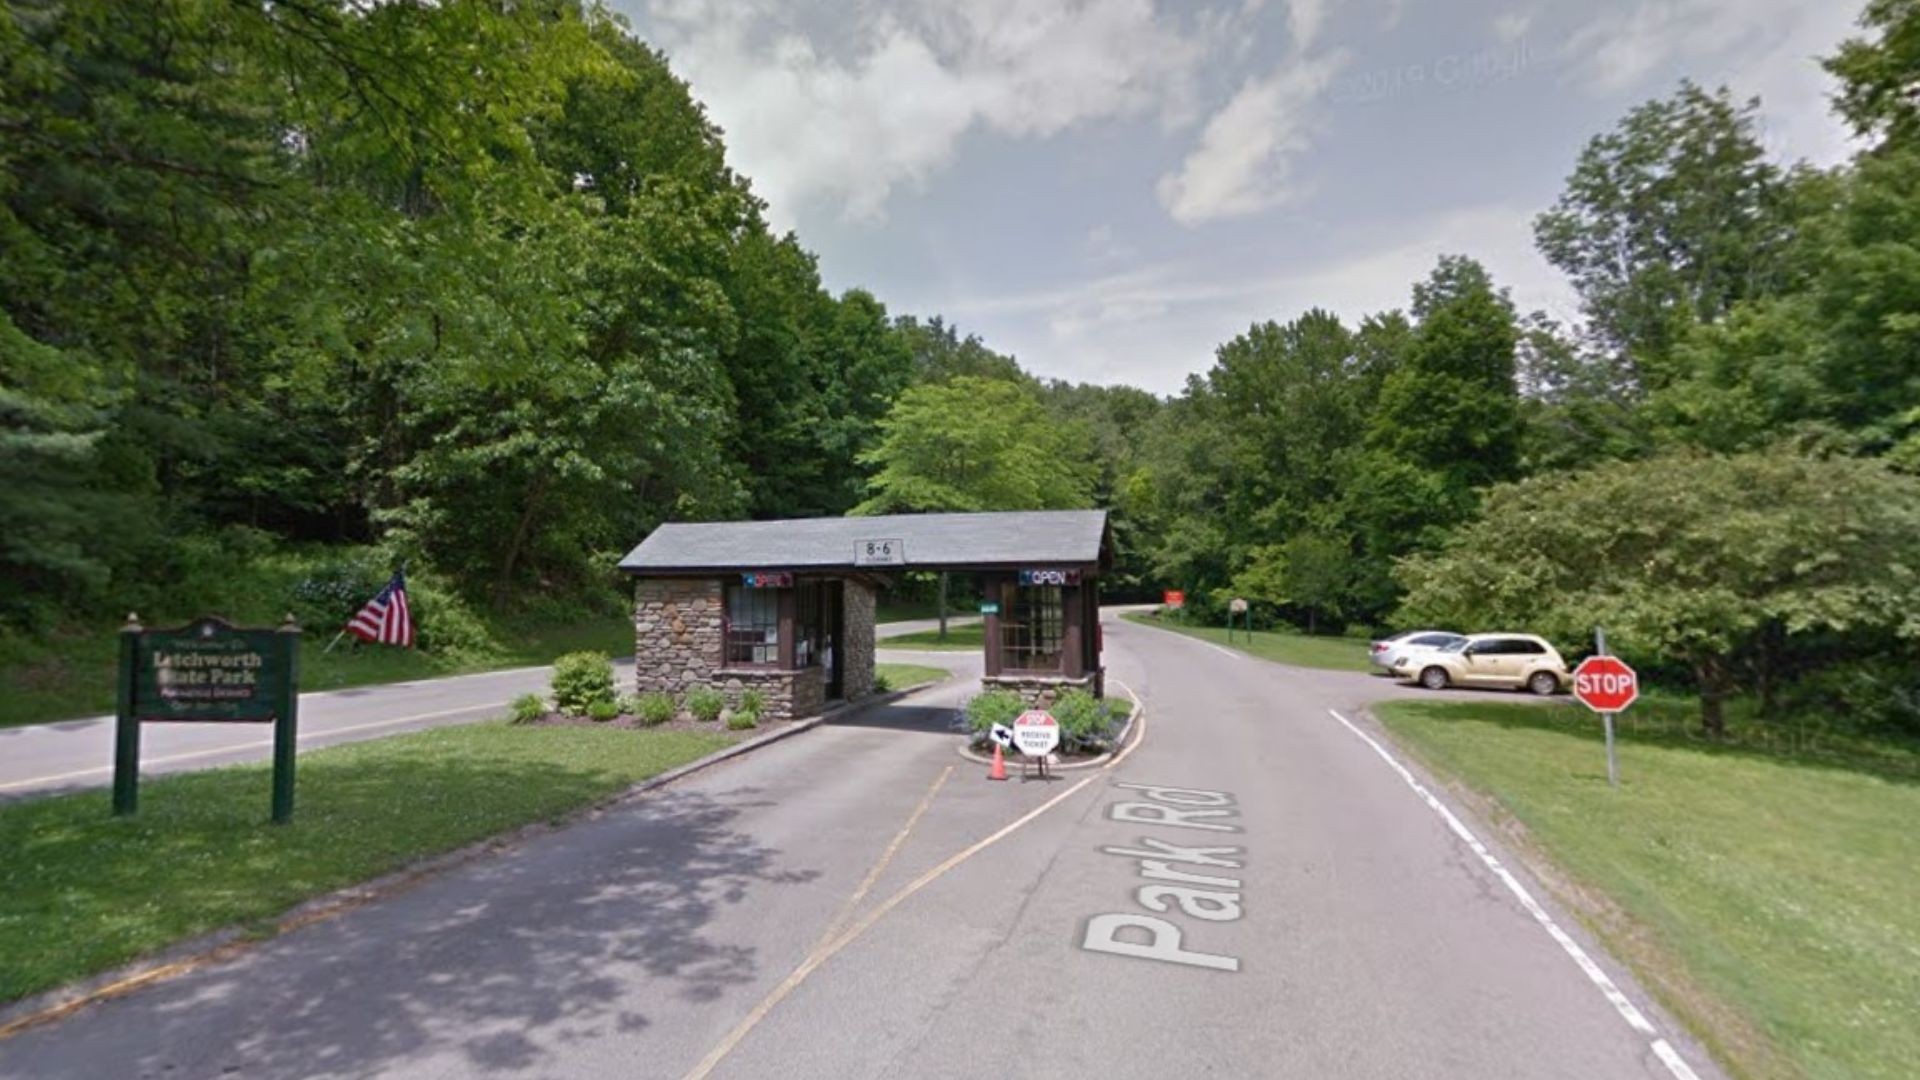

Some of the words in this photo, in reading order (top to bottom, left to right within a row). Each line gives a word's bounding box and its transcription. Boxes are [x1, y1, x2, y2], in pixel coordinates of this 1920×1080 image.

[1031, 570, 1066, 585] OPEN
[211, 668, 255, 684] Park
[1578, 673, 1631, 695] STOP
